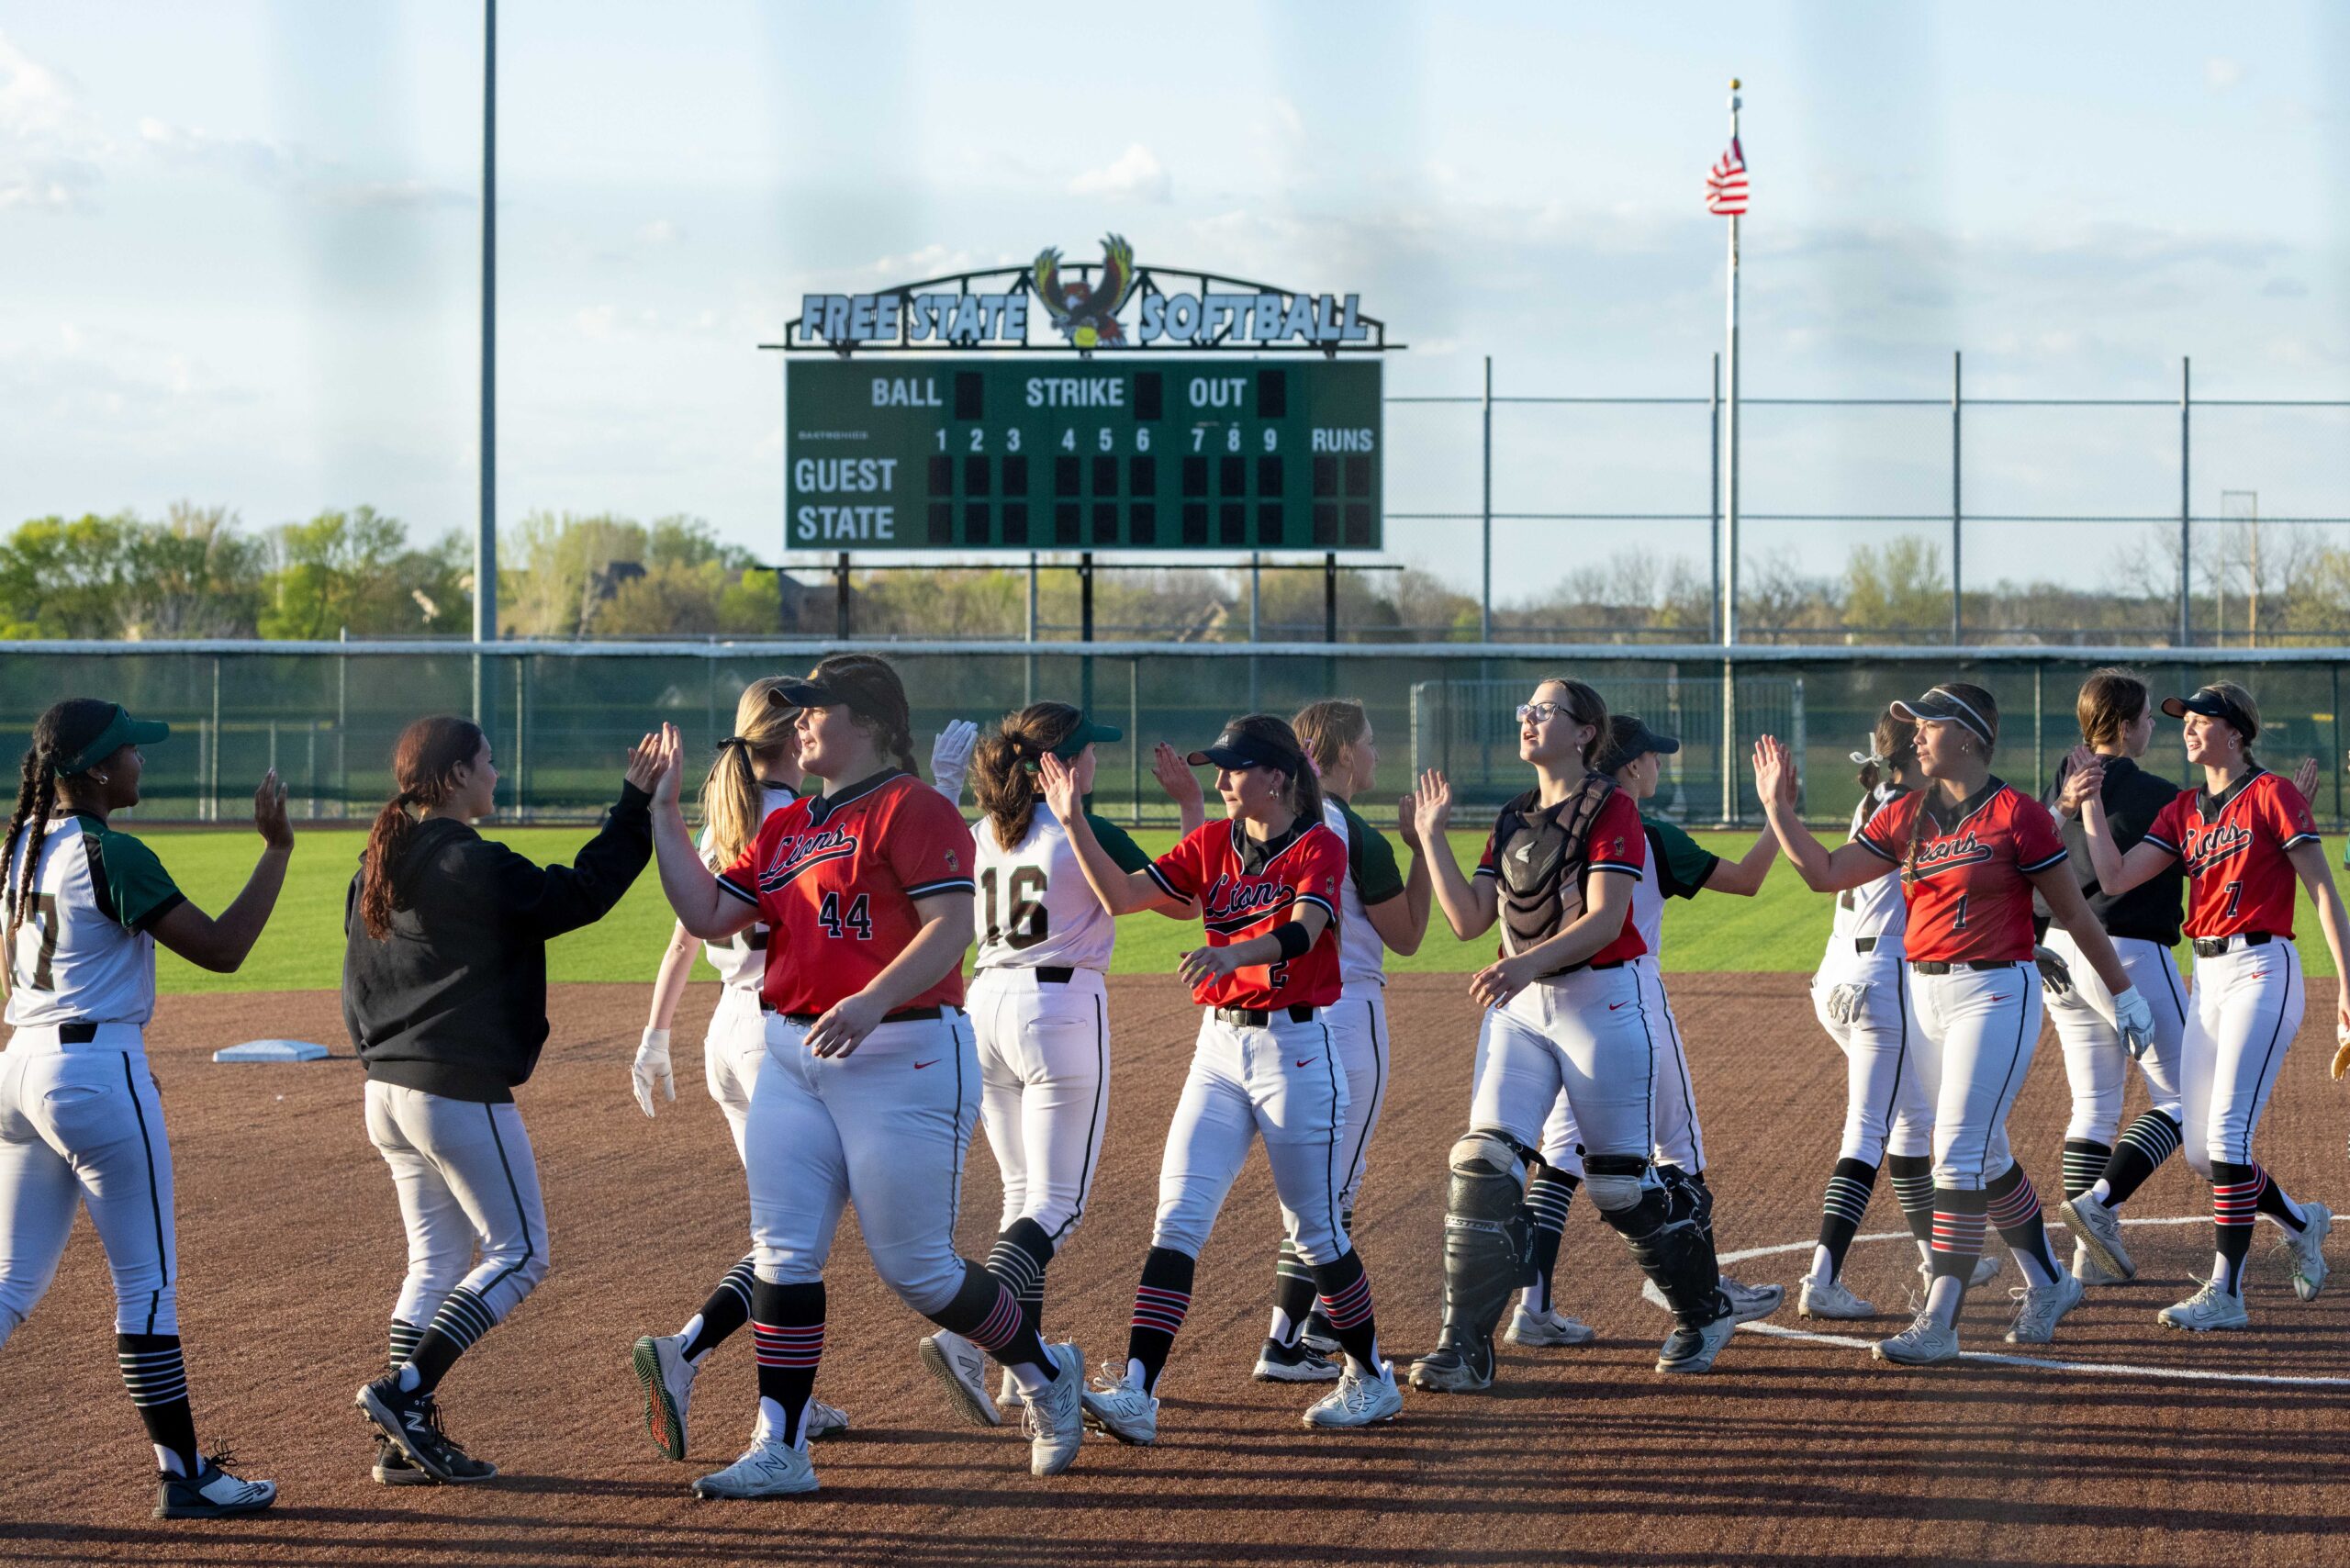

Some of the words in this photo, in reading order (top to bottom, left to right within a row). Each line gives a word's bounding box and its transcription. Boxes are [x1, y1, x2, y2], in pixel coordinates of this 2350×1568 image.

[800, 294, 901, 341] FREE
[911, 293, 1028, 341] STATE
[1139, 294, 1368, 341] SOFTBALL
[871, 377, 943, 407] BALL
[1025, 377, 1125, 408] STRIKE
[1189, 377, 1248, 408] OUT
[935, 428, 946, 452] 1
[969, 428, 984, 452] 2
[1006, 427, 1021, 452] 3
[1061, 428, 1076, 452] 4
[1099, 428, 1113, 452] 5
[1136, 427, 1150, 452] 6
[1191, 428, 1205, 453] 7
[1227, 428, 1241, 453] 8
[1263, 428, 1277, 453] 9
[1312, 428, 1374, 453] RUNS
[794, 457, 899, 494] GUEST
[797, 505, 895, 541] STATE
[758, 823, 846, 881] Lions
[818, 891, 872, 940] 44
[980, 865, 1048, 951] 16
[1953, 894, 1969, 929] 1
[2224, 880, 2243, 918] 7
[1113, 1396, 1143, 1418] N
[755, 1452, 788, 1479] N
